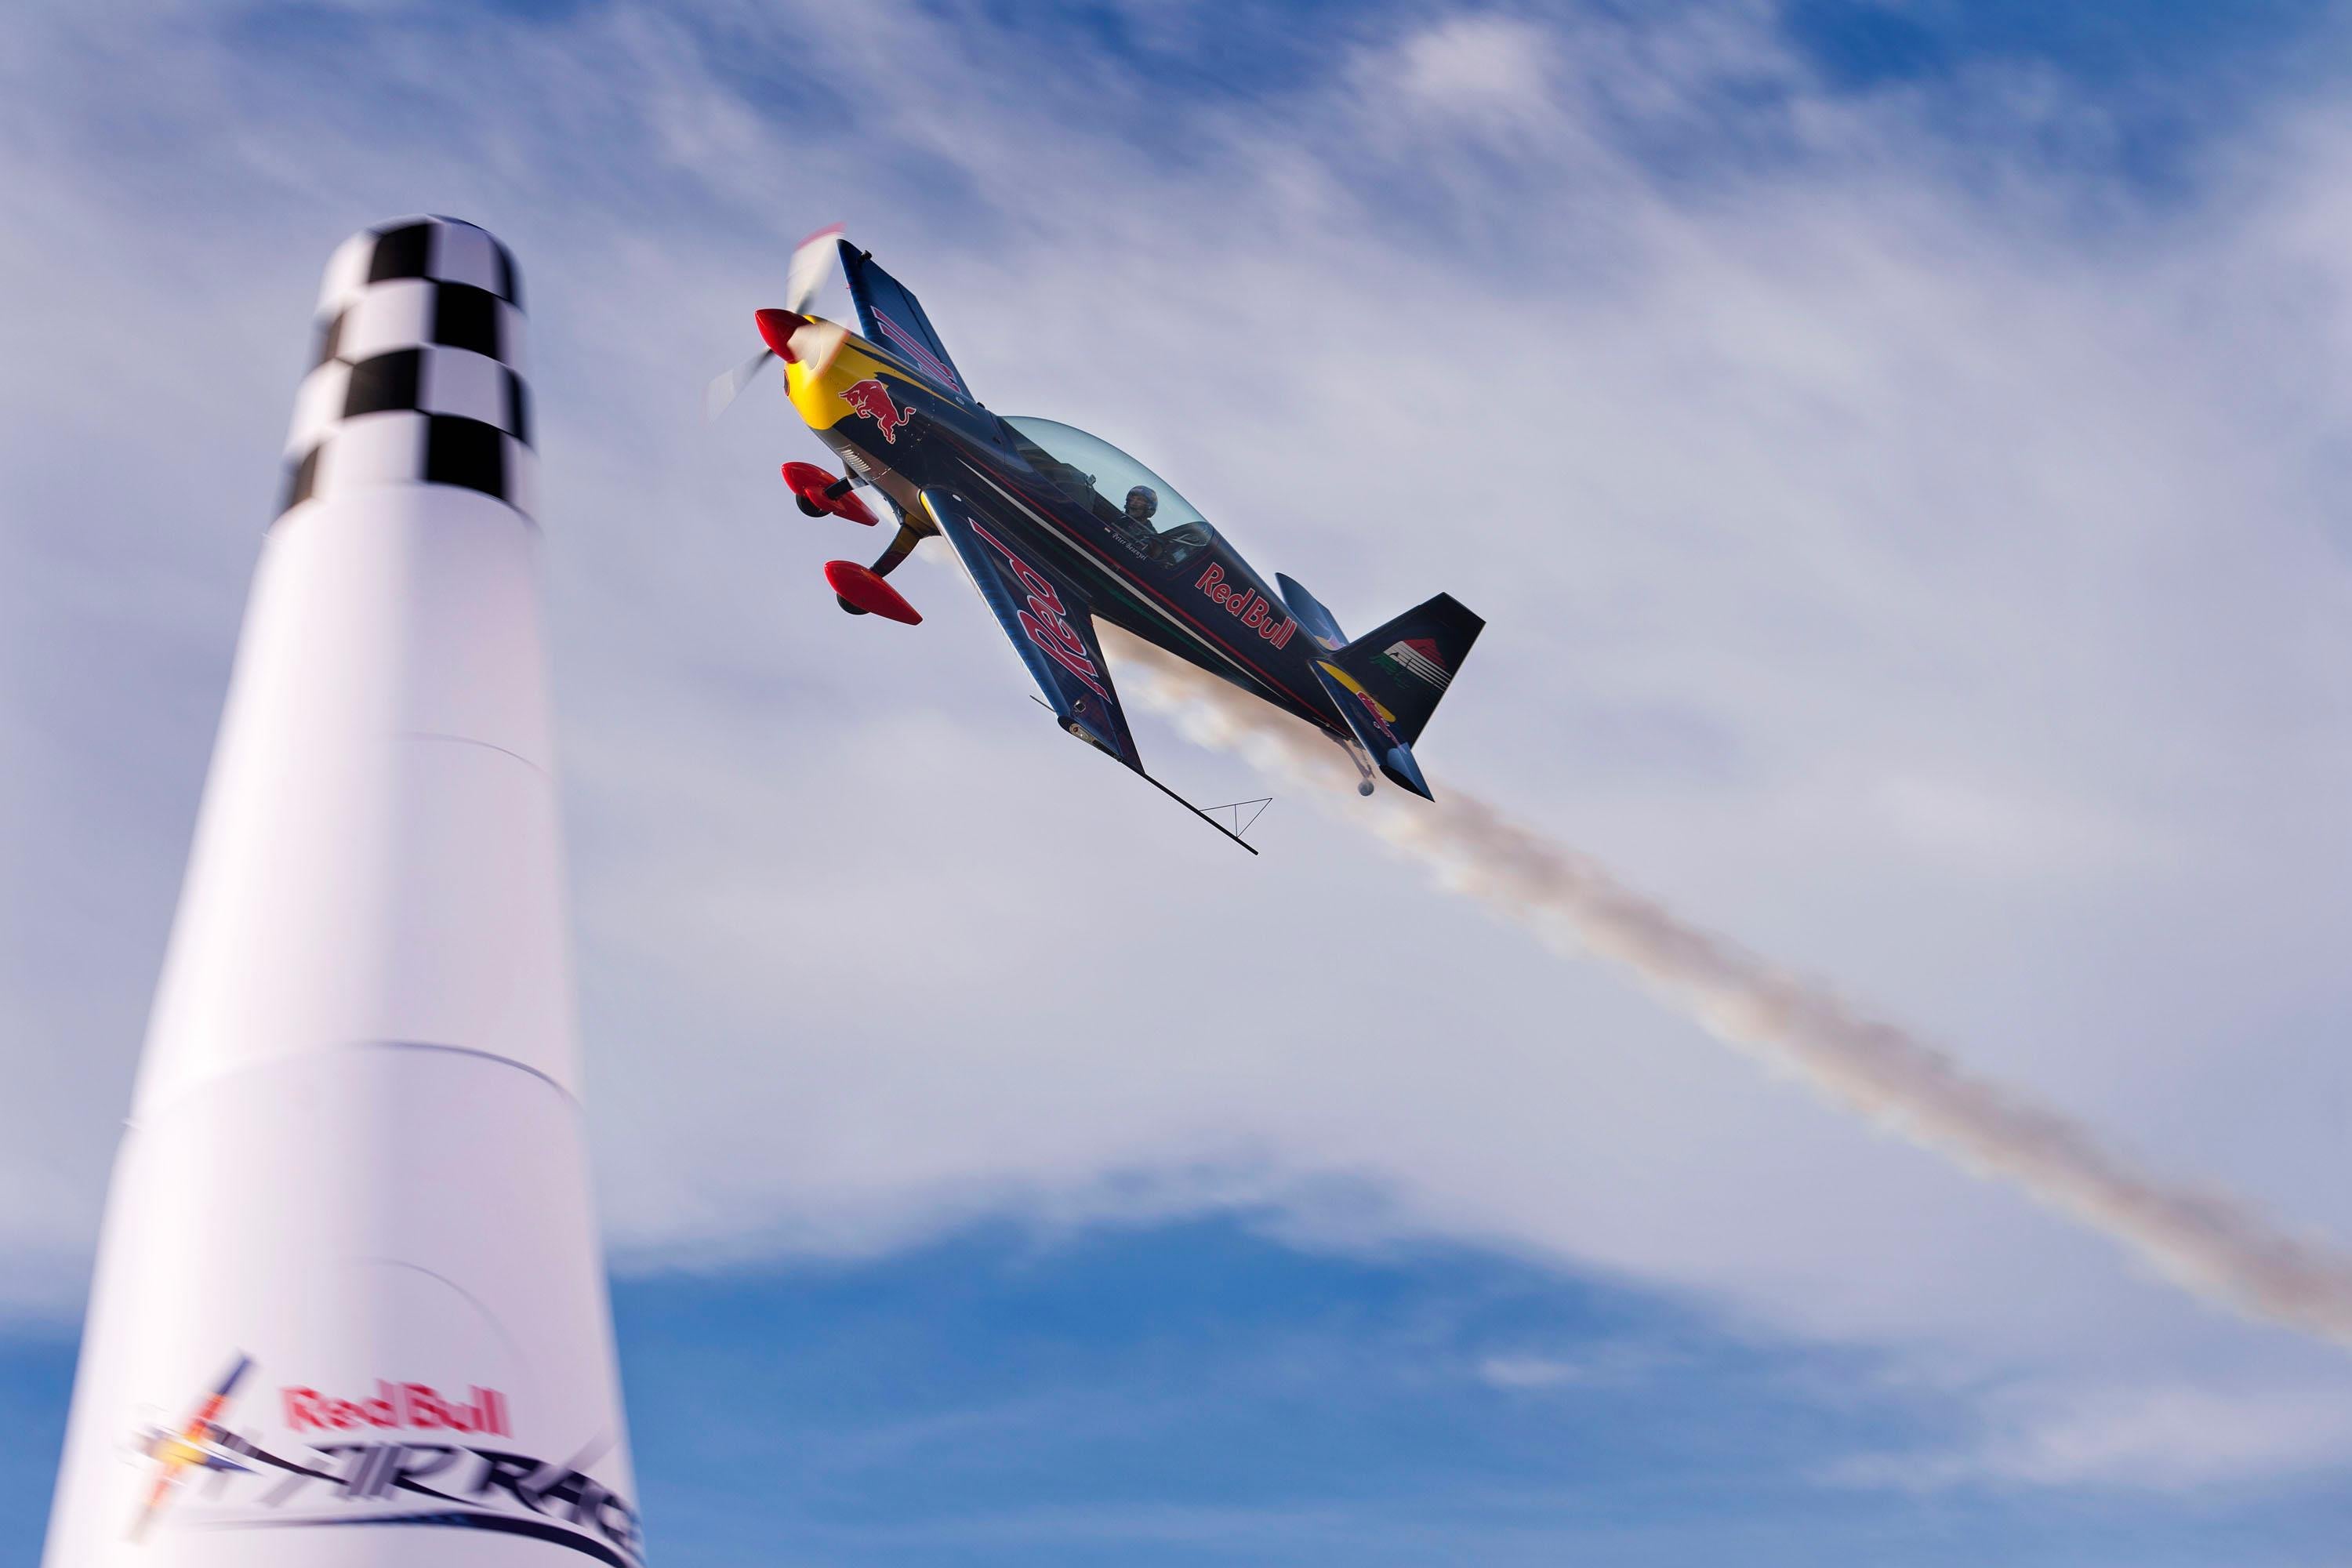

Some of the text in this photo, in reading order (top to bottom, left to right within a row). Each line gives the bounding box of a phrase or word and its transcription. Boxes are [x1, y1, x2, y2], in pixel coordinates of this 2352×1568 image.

[968, 517, 1112, 704] Red
[1194, 561, 1298, 650] Red Bull
[281, 1378, 514, 1438] Red Bull
[259, 1441, 480, 1507] AIR
